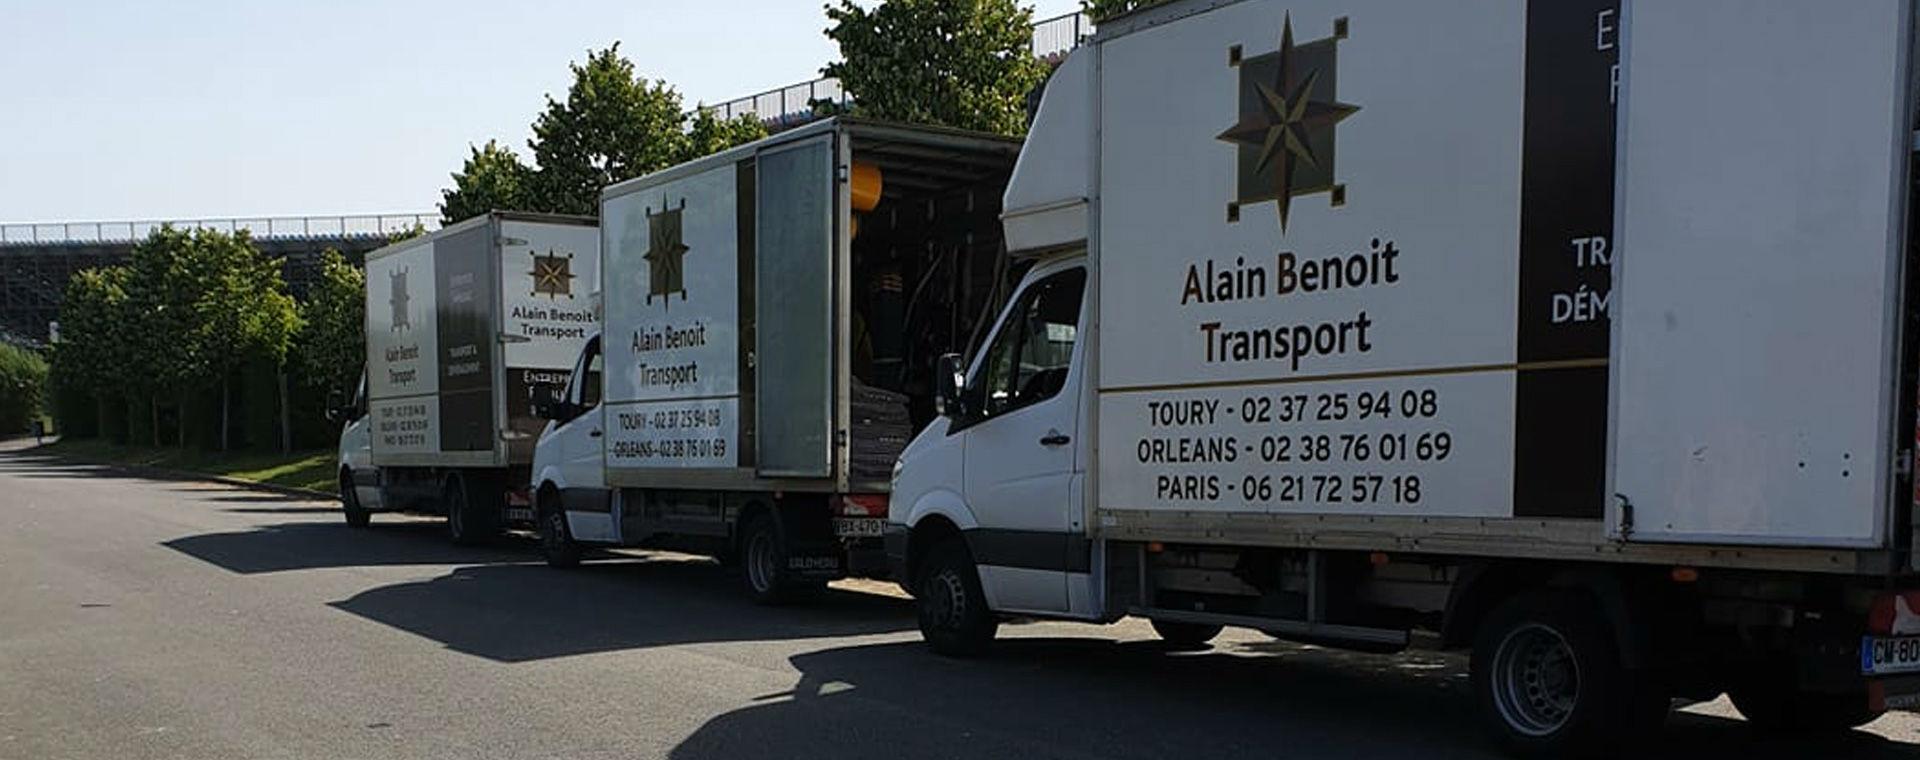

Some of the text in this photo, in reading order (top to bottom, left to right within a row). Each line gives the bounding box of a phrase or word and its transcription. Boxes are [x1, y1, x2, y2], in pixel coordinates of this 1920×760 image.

[1571, 236, 1612, 268] TR
[1181, 238, 1400, 305] Alain Benoit
[512, 306, 593, 323] Alain Benoit
[521, 324, 585, 340] Transport
[632, 320, 705, 353] Alain Benoit
[1201, 311, 1372, 371] Transport
[640, 361, 698, 391] Transport
[655, 411, 666, 429] 02
[668, 410, 679, 428] 37
[681, 409, 692, 428] 25
[694, 408, 706, 428] 94
[1148, 400, 1219, 426] TOURY
[1241, 397, 1271, 423] 02
[1279, 395, 1308, 422] 37
[1316, 393, 1349, 421] 25
[1358, 391, 1391, 420] 94
[1400, 389, 1438, 418] 08
[614, 440, 652, 458] ORLEANS
[660, 440, 671, 457] 02
[673, 440, 684, 457] 38
[686, 439, 698, 457] 76
[700, 439, 711, 457] 01
[713, 438, 726, 457] 69
[1137, 436, 1238, 463] ORLEANS
[1260, 435, 1291, 462] 02
[1299, 434, 1331, 461] 38
[1340, 433, 1370, 461] 76
[1378, 432, 1406, 460] 01
[1415, 431, 1452, 461] 69
[1157, 475, 1220, 500] PARIS
[1242, 476, 1272, 501] 06
[1280, 475, 1303, 501] 21
[1312, 475, 1342, 501] 72
[1352, 475, 1383, 502] 57
[1392, 475, 1421, 503] 18
